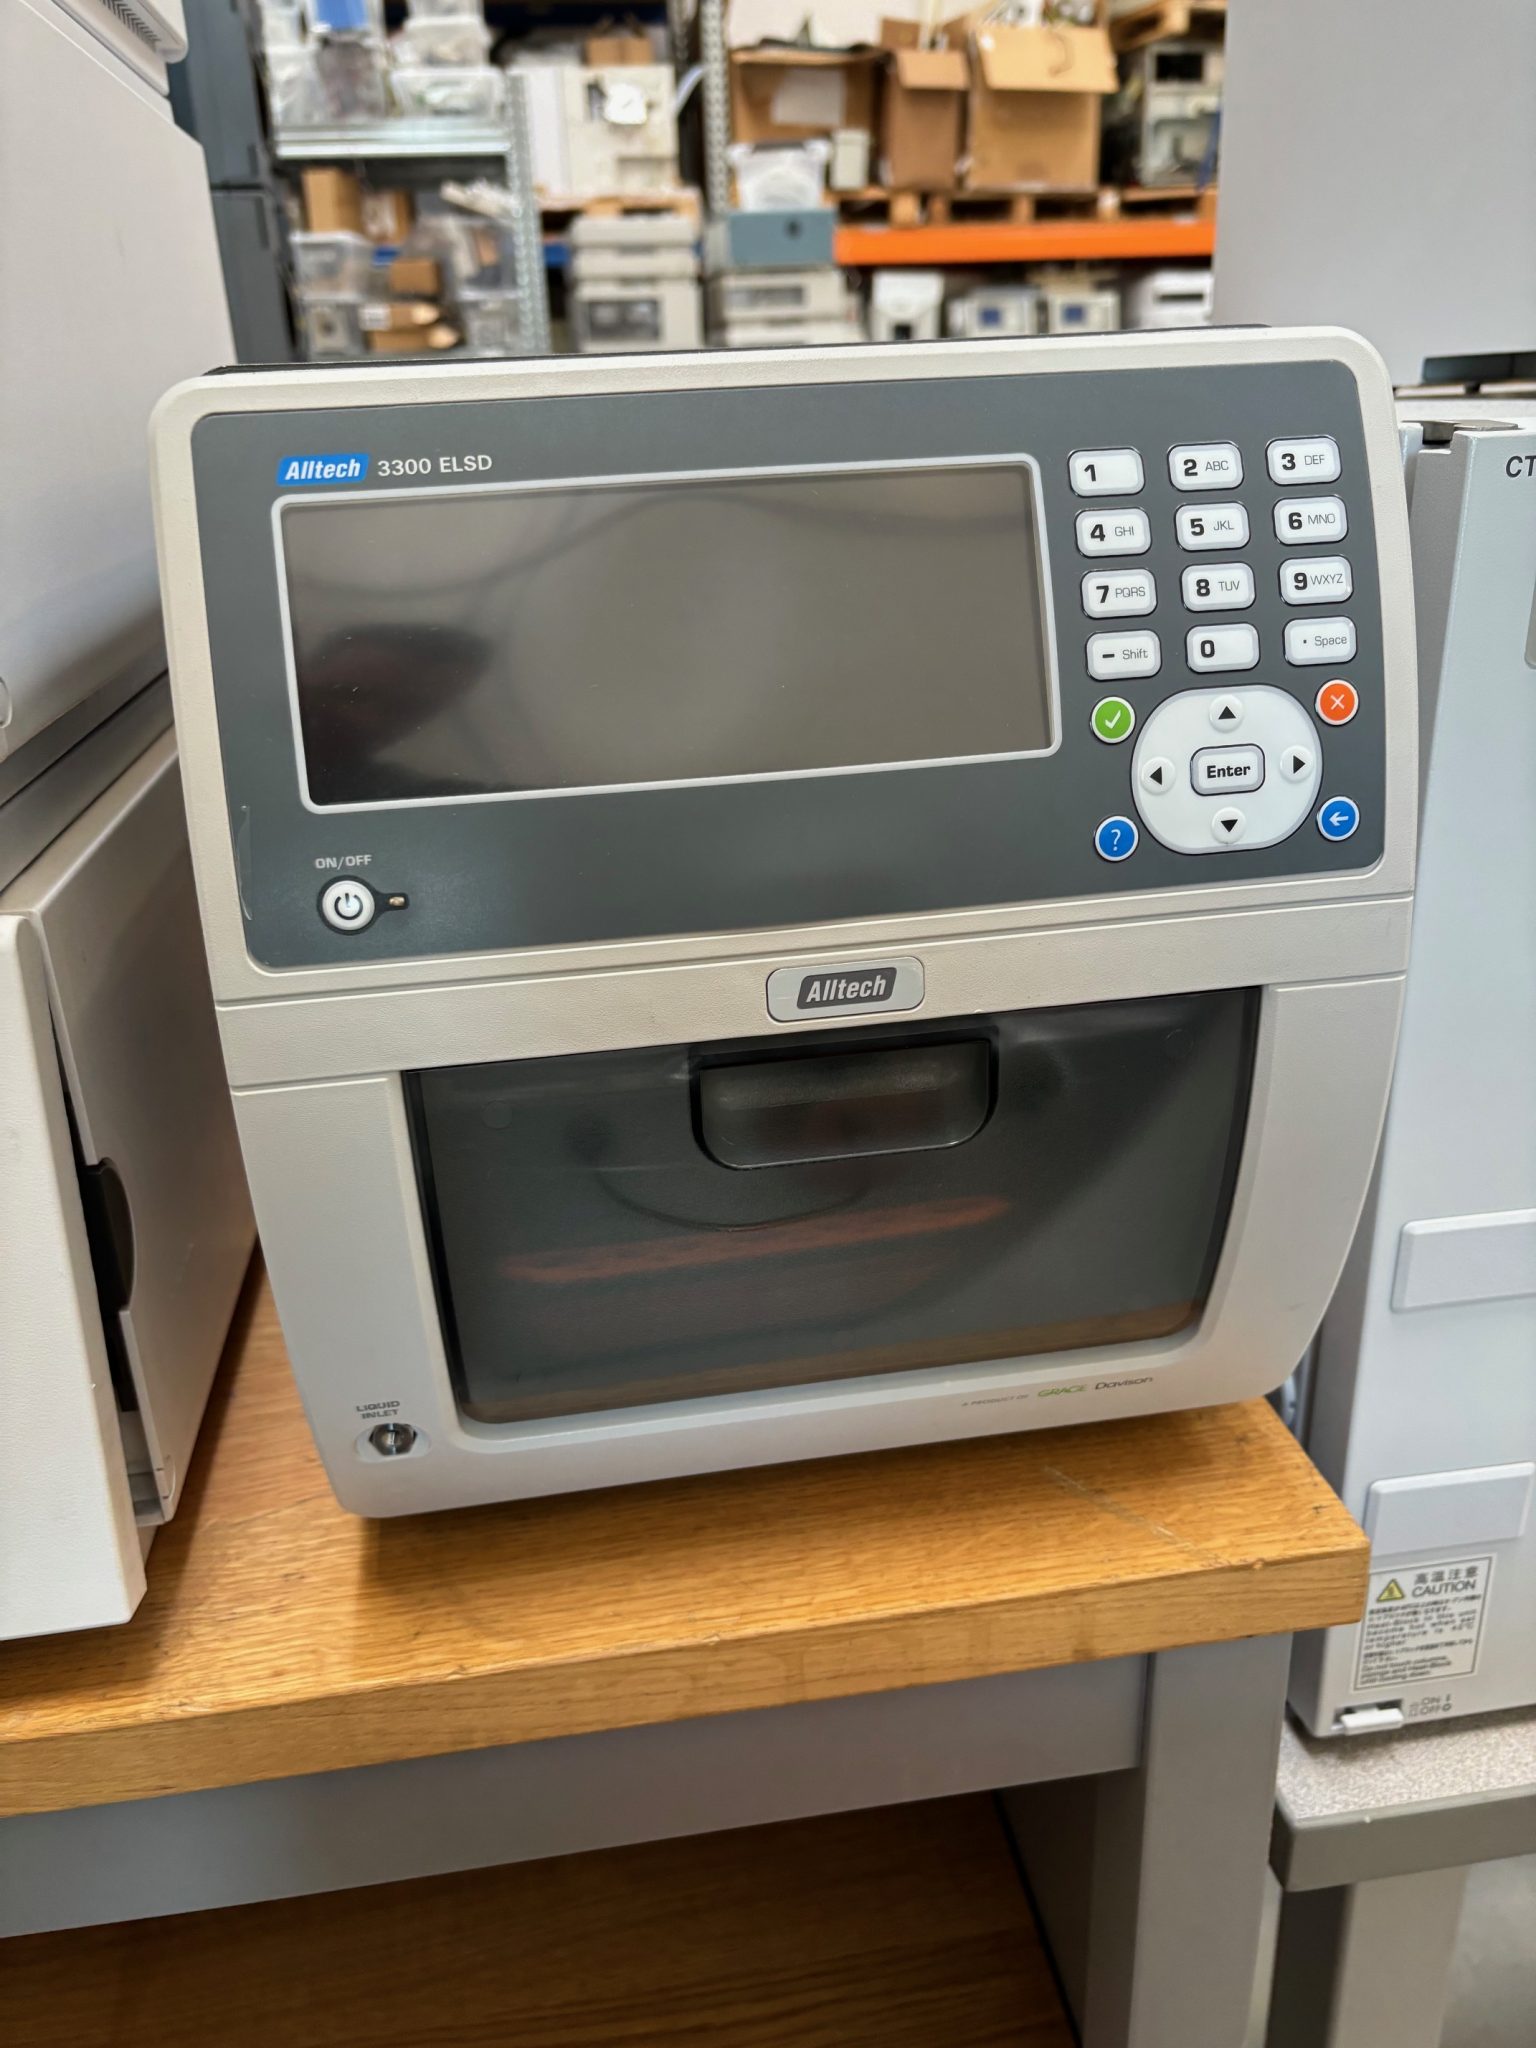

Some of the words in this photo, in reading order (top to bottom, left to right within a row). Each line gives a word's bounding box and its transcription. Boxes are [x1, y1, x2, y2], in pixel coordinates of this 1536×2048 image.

[285, 459, 361, 481] Alltech
[377, 458, 432, 476] 3300
[439, 455, 492, 473] ELSD
[1183, 459, 1198, 477] 2
[1205, 460, 1229, 472] ABC
[1281, 453, 1296, 471] 3
[1304, 455, 1325, 465] DEF
[1506, 456, 1536, 478] CT
[1084, 464, 1097, 482] 1
[1190, 518, 1205, 536] 5
[1213, 520, 1235, 531] JKL
[1288, 512, 1303, 530] 6
[1307, 514, 1336, 525] MNO
[1090, 524, 1106, 542] 4
[1114, 526, 1134, 537] GHI
[1195, 579, 1211, 597] 8
[1218, 581, 1240, 592] TUV
[1293, 573, 1308, 590] 9
[1310, 573, 1344, 585] WXYZ
[1096, 585, 1110, 603] 7
[1115, 587, 1146, 598] PQRS
[1201, 640, 1215, 658] 0
[1314, 635, 1348, 646] Space
[1122, 648, 1148, 661] Shift
[1206, 764, 1251, 778] Enter
[315, 855, 372, 870] ON/OFF
[806, 975, 886, 1002] Alltech
[1038, 1384, 1088, 1397] GRACE
[1095, 1377, 1154, 1390] Davison
[356, 1401, 400, 1412] LIQUID
[362, 1409, 399, 1419] INLET
[1412, 1580, 1476, 1598] CAUTION
